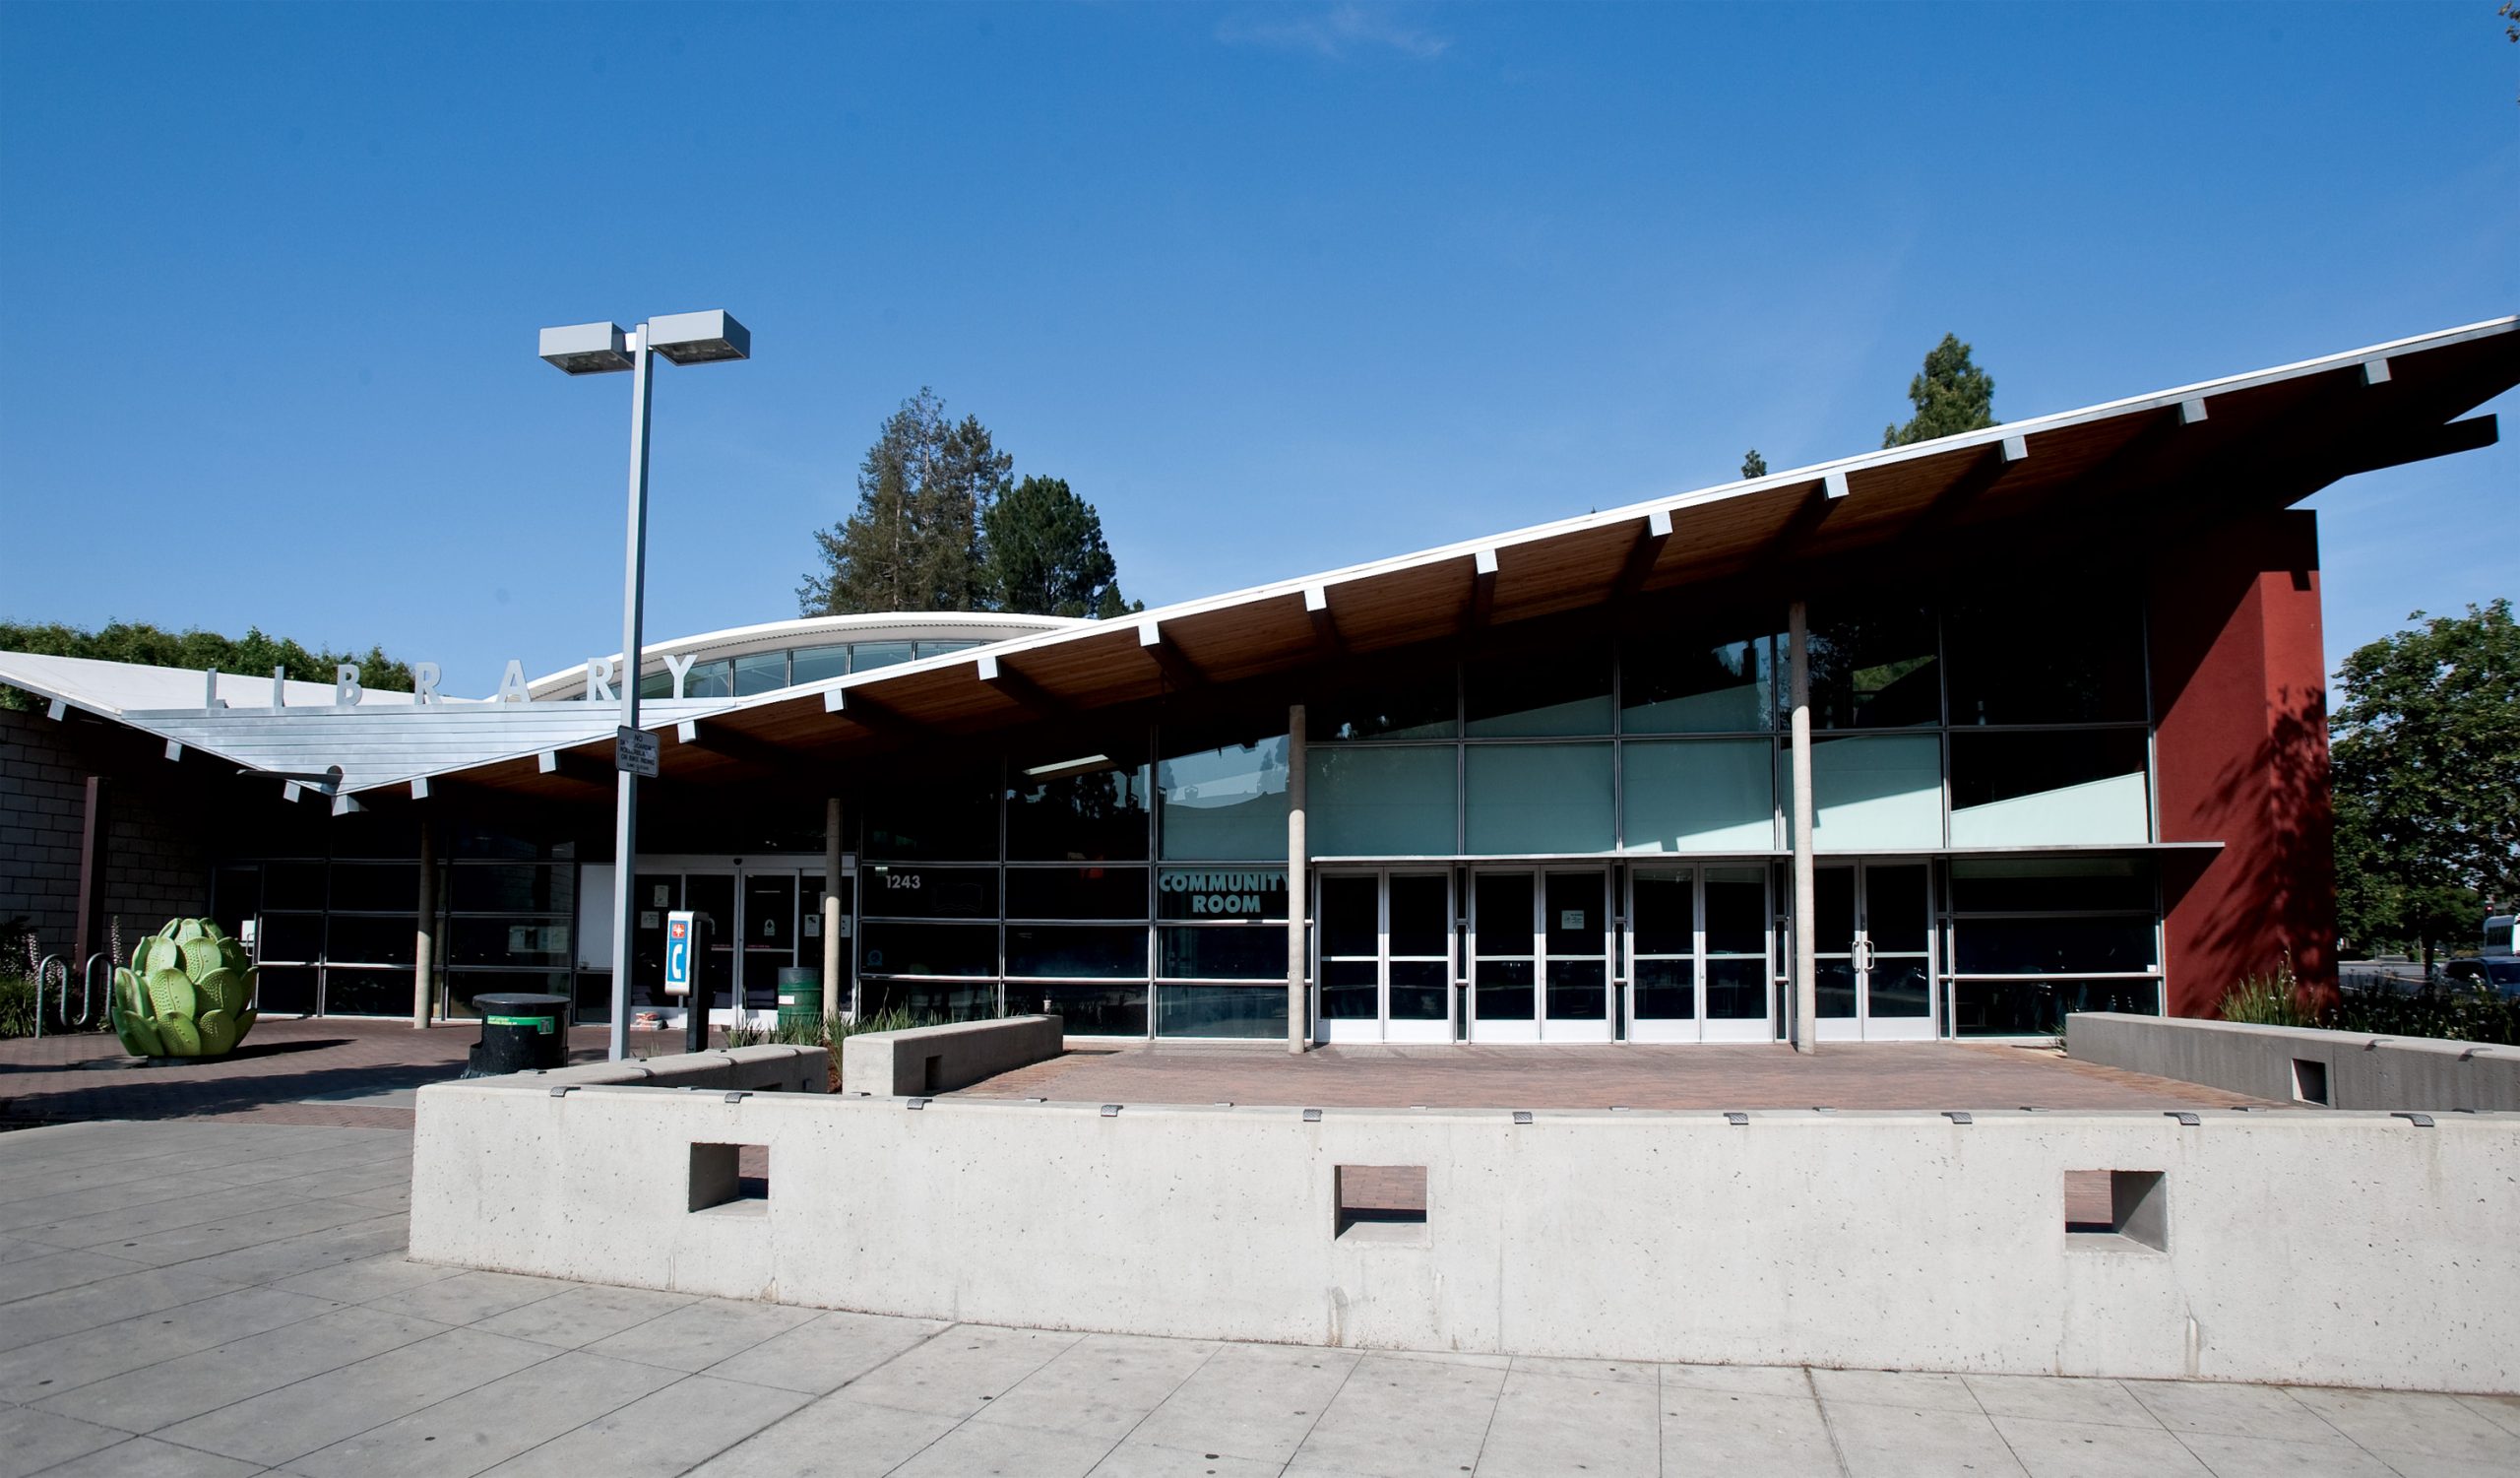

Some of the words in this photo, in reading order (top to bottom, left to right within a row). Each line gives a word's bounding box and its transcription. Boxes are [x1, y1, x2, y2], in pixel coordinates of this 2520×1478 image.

[207, 655, 698, 709] LIBRARY
[886, 874, 921, 889] 1243
[1192, 894, 1261, 913] ROOM
